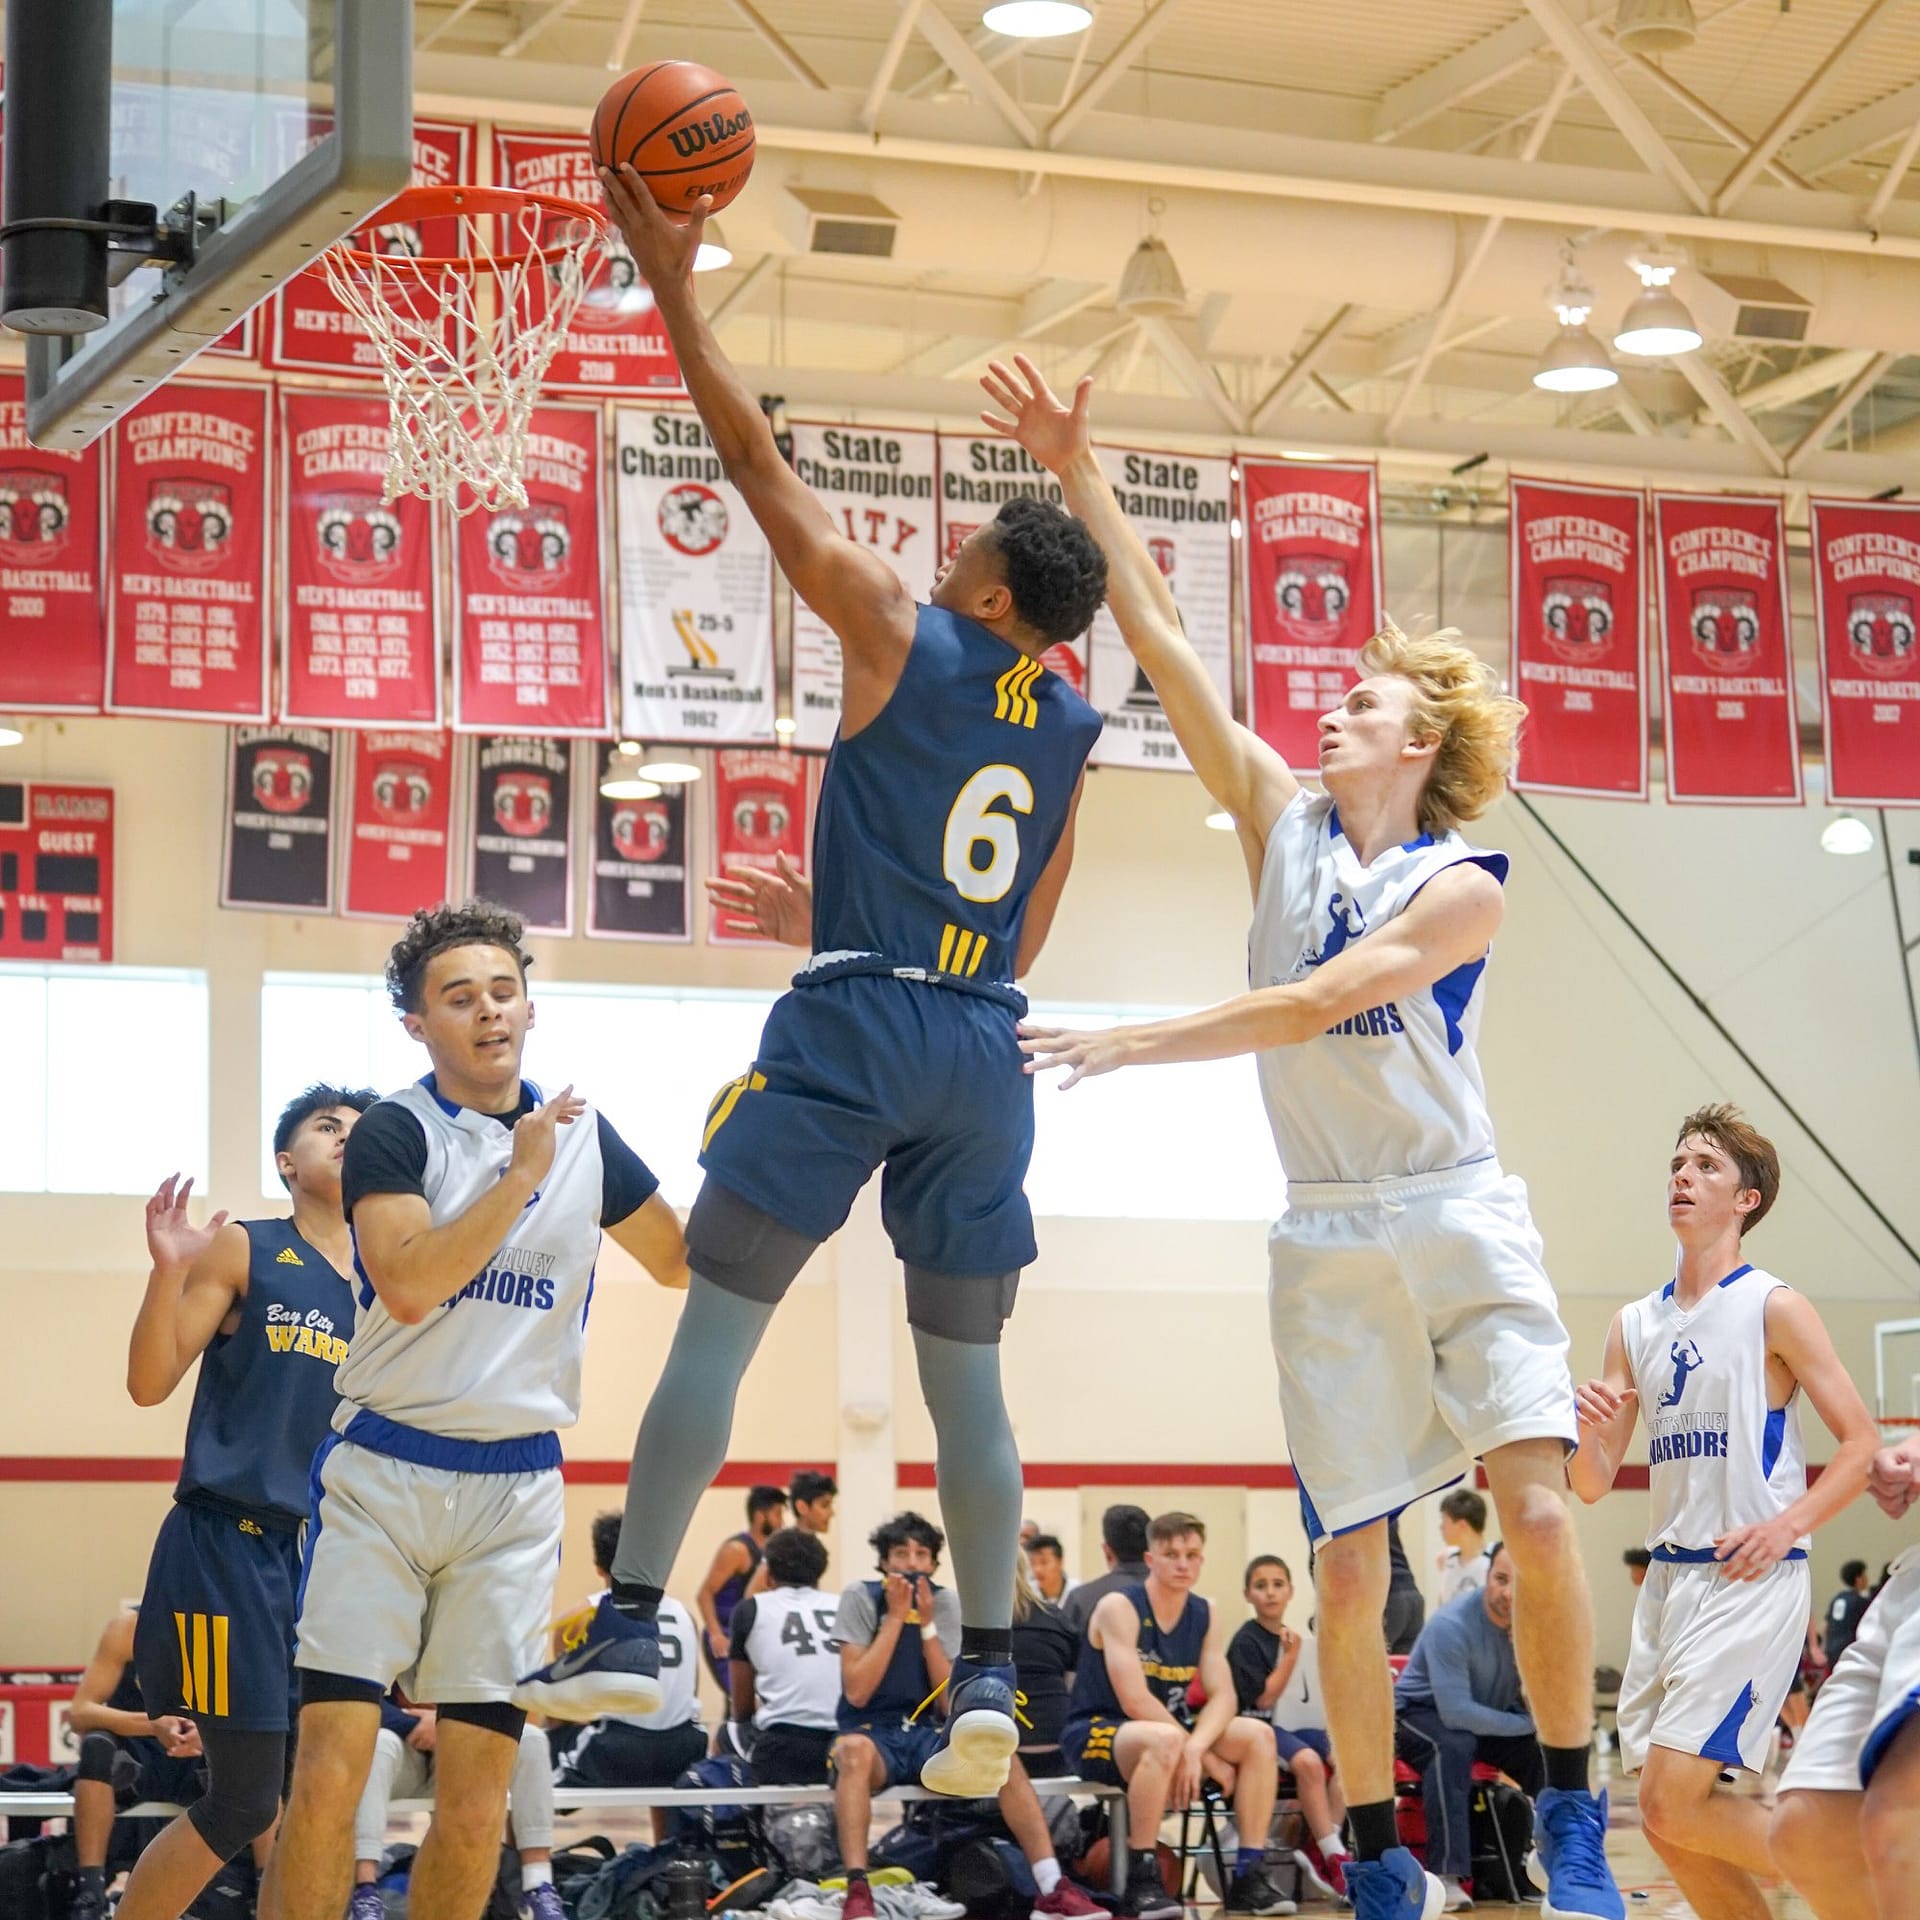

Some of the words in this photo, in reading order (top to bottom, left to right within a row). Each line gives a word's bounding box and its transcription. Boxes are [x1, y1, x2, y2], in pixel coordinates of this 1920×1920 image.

[667, 109, 750, 157] Wilson
[515, 152, 597, 187] CONFE
[568, 333, 667, 357] BASKETBALL
[127, 411, 254, 452] CONFERENCE
[823, 431, 902, 464] State
[134, 438, 248, 473] CHAMPIONS
[798, 457, 932, 498] Champion
[1124, 455, 1198, 490] State
[1254, 492, 1365, 525] CONFERENCE
[1261, 516, 1360, 548] CHAMPIONS
[1525, 515, 1631, 556] CONFERENCE
[1669, 526, 1772, 562] CONFERENCE
[1531, 539, 1626, 573] CHAMPIONS
[1677, 550, 1768, 580] CHAMPIONS
[163, 575, 254, 603] BASKETBALL
[336, 587, 426, 612] BASKETBALL
[507, 595, 594, 620] BASKETBALL
[698, 613, 733, 631] 25-5
[1567, 665, 1637, 692] BASKETBALL
[1717, 676, 1786, 697] BASKETBALL
[803, 691, 842, 709] Men'
[38, 831, 96, 853] GUEST
[942, 764, 1035, 903] 6
[266, 1303, 302, 1326] Bay
[304, 1309, 335, 1335] City
[781, 1609, 842, 1656] 45
